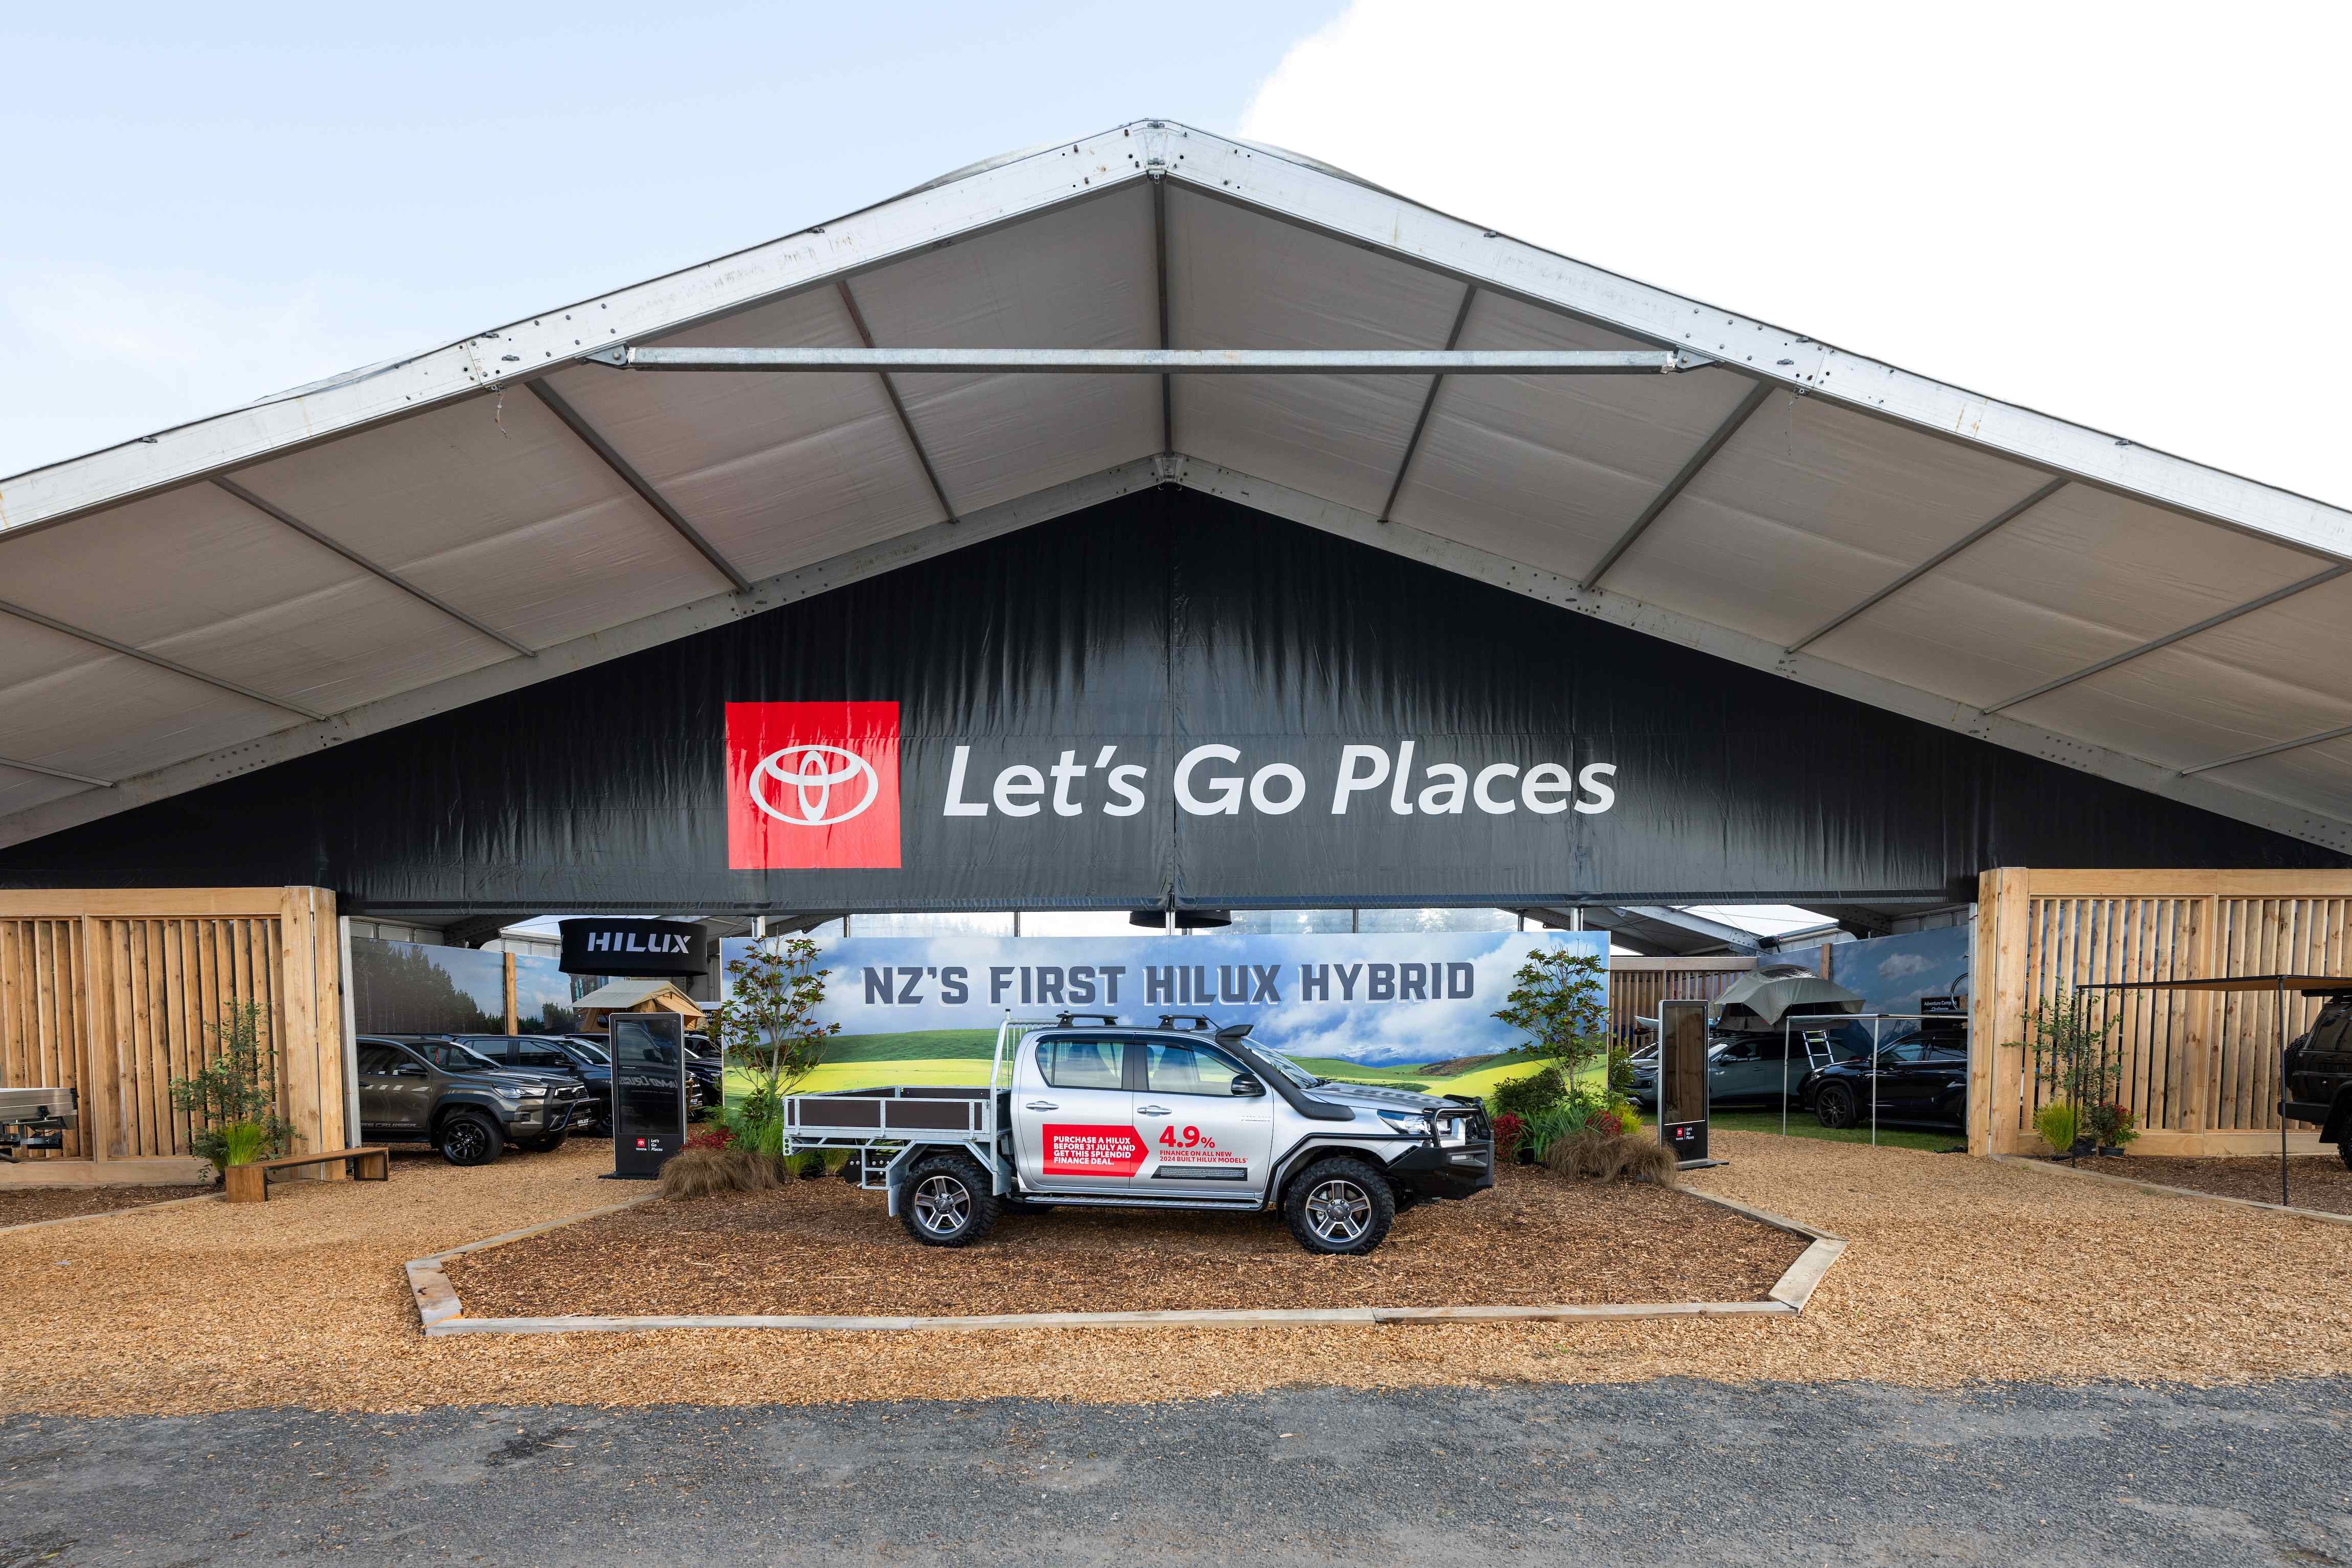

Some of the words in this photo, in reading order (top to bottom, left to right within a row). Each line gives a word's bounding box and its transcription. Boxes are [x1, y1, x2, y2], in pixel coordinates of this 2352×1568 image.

[943, 745, 1147, 817] Let's
[1174, 744, 1306, 816] Go
[1331, 741, 1617, 815] Places
[587, 932, 691, 953] HILUX
[862, 966, 969, 1006] NZ'S
[988, 966, 1126, 1006] FIRST
[1143, 964, 1282, 1006] HILUX
[1299, 962, 1474, 1003] HYBRID
[1159, 1125, 1215, 1148] 4.9%
